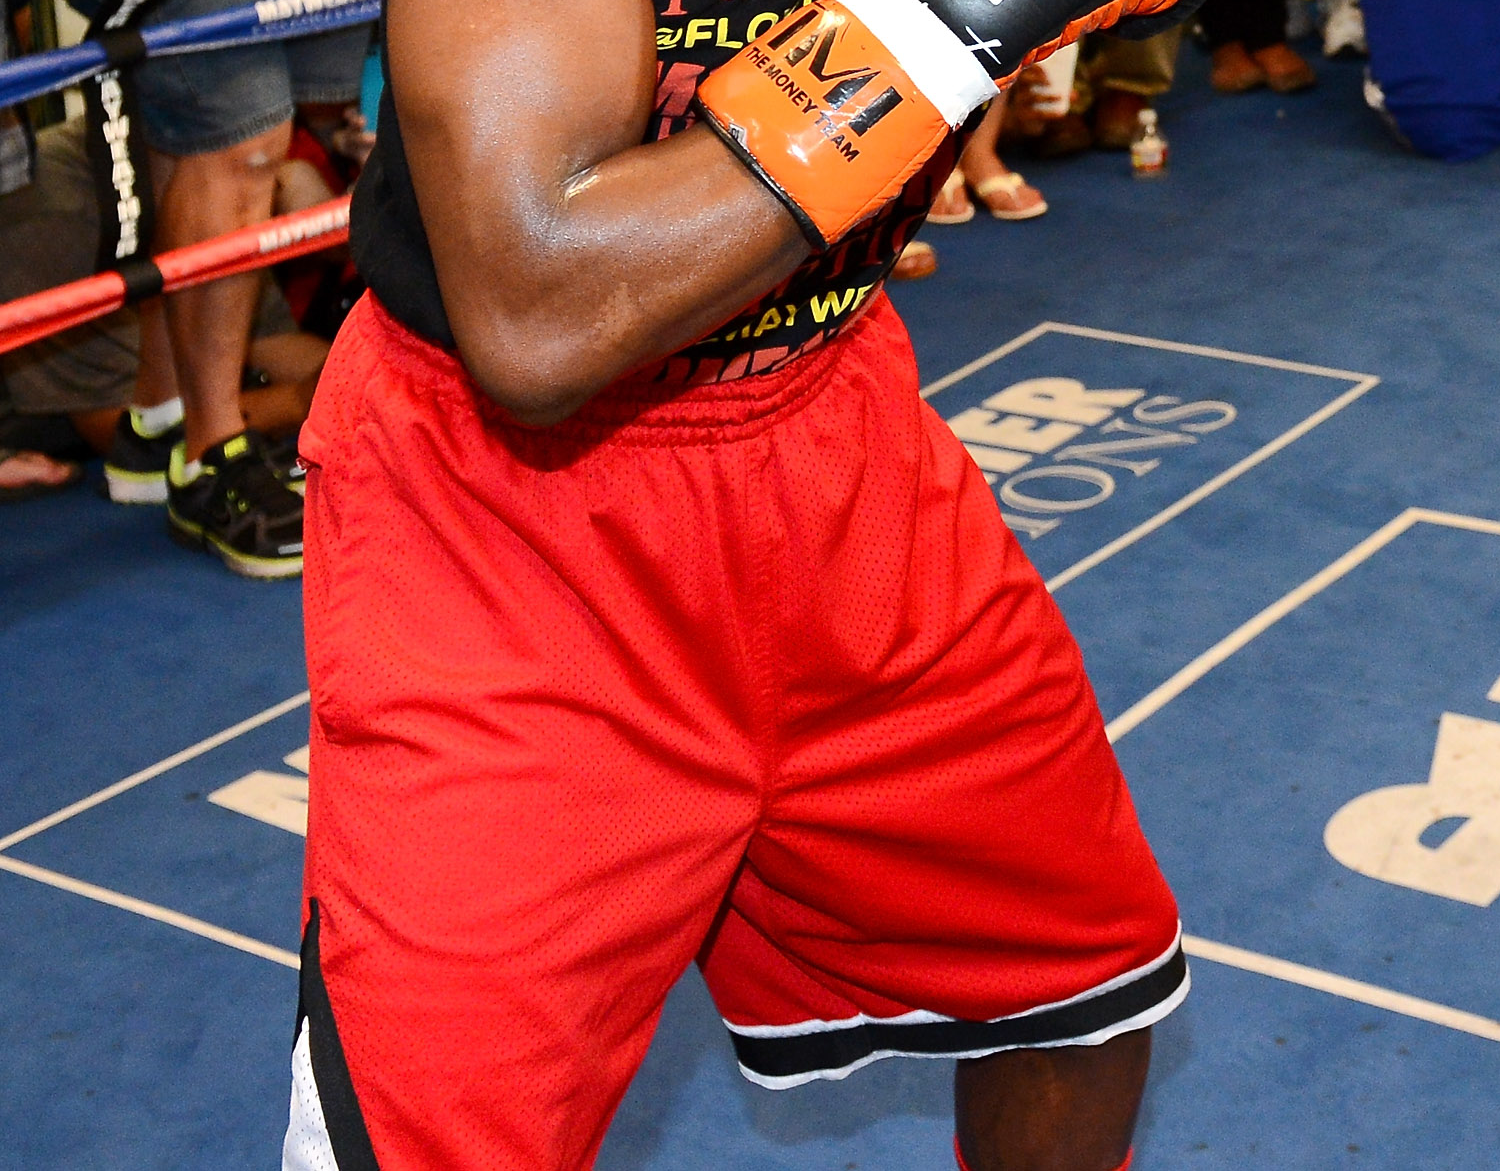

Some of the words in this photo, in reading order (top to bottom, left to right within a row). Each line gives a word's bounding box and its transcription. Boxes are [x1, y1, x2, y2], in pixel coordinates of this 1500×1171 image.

[746, 46, 772, 70] THE
[763, 62, 818, 115] MONEY
[814, 110, 861, 163] TEAM
